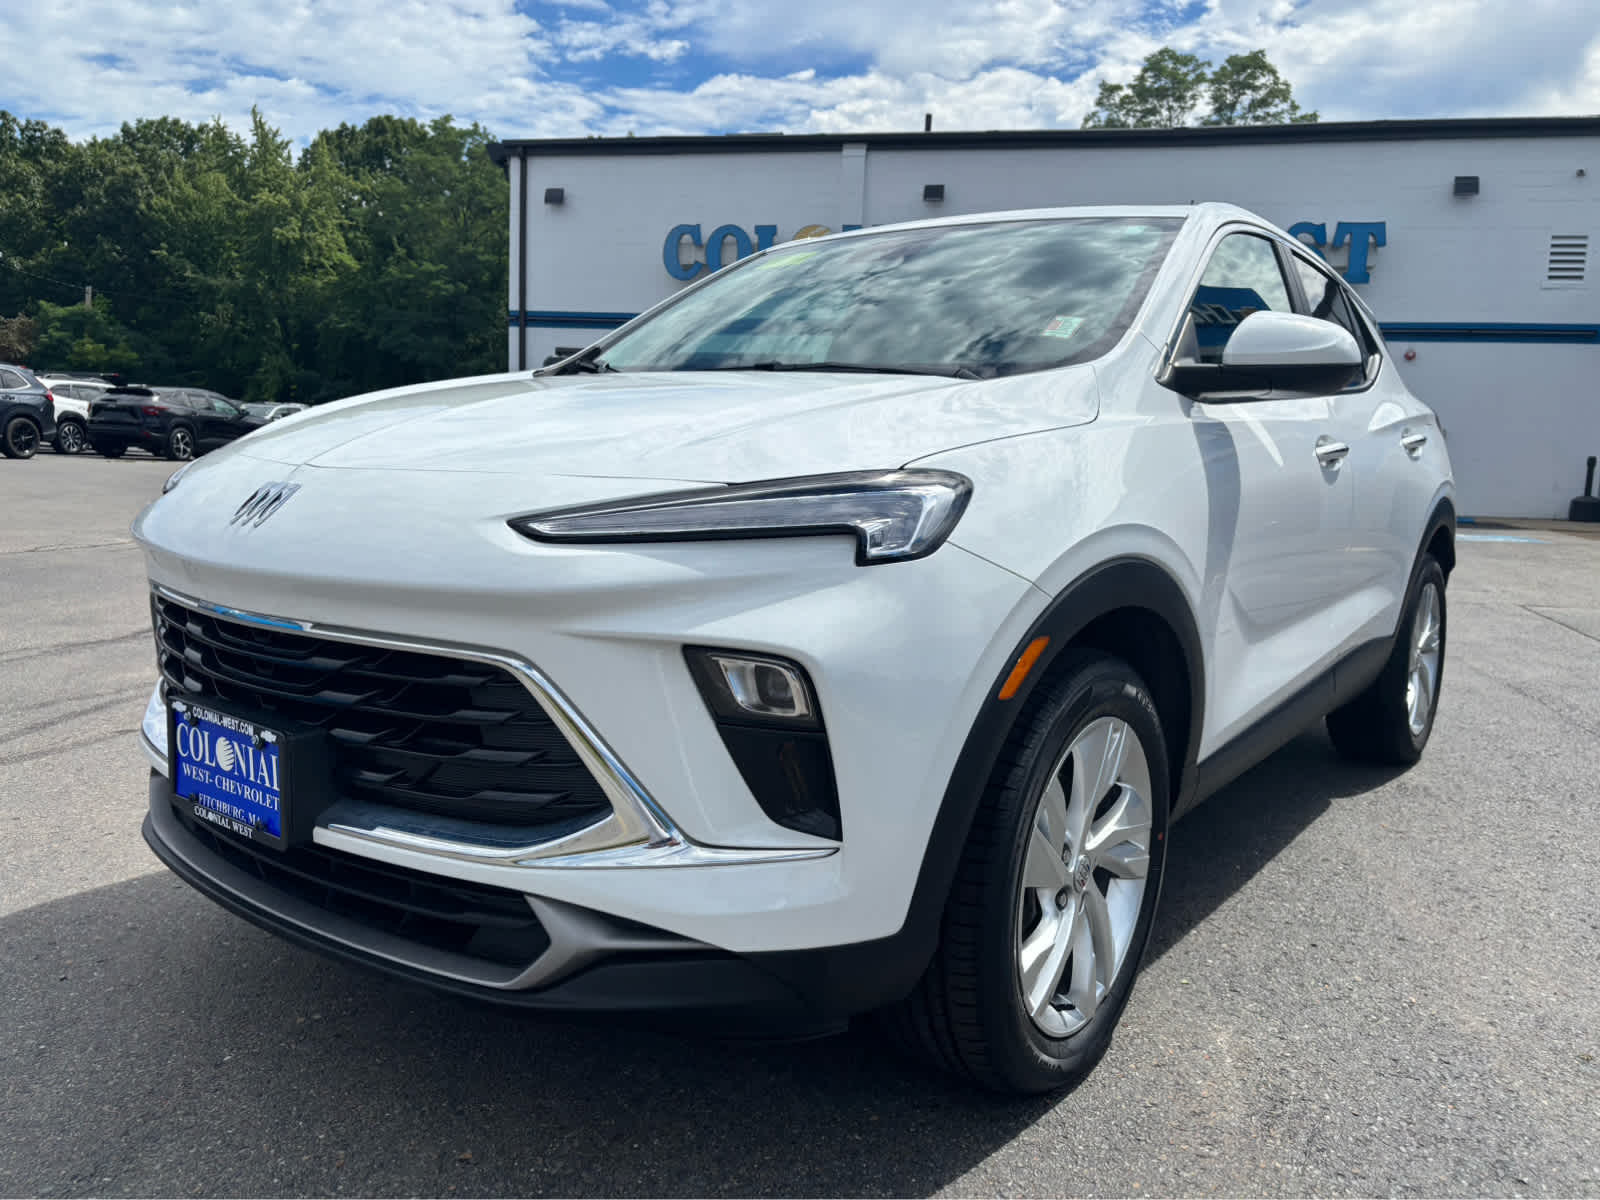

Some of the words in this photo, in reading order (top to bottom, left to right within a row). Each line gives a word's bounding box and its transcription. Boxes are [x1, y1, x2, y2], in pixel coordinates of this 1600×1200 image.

[193, 706, 254, 736] COLONIAL-WEST.COM
[176, 722, 280, 792] COLONIAL
[215, 774, 280, 811] CHEVROLET
[194, 805, 231, 830] COLONIAL
[232, 821, 254, 839] WEST
